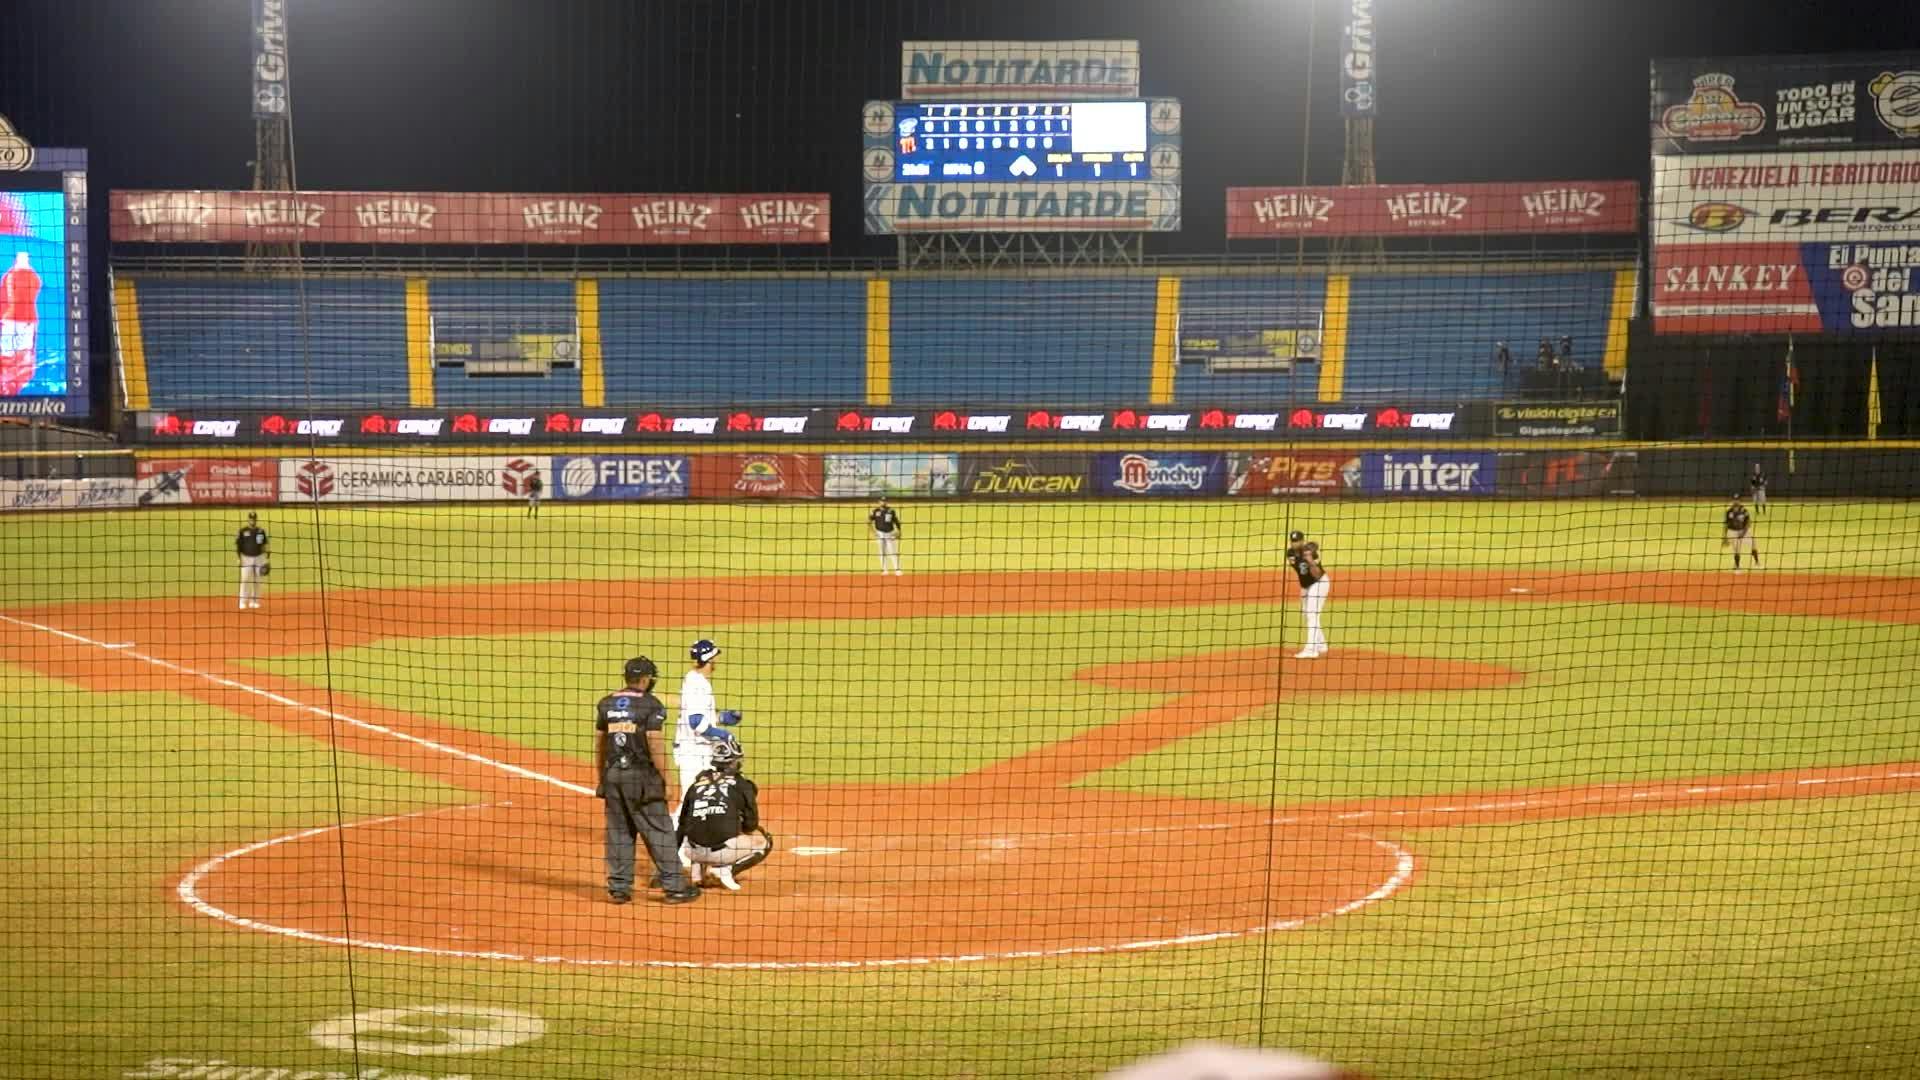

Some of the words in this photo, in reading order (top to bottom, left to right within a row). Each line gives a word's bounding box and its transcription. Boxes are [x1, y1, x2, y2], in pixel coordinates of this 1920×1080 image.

[908, 50, 1131, 84] NOTITARDE
[1776, 84, 1828, 101] TODO
[1831, 80, 1855, 95] EN
[1776, 101, 1802, 114] UN
[1806, 93, 1856, 111] SOLO
[1776, 107, 1856, 131] LUGAR
[1690, 166, 1799, 190] VENEZUELA
[128, 197, 213, 229] HEINZ
[245, 198, 326, 229] HEINZ
[356, 199, 436, 229] HEINZ
[523, 200, 603, 230] HEINZ
[632, 200, 712, 230] HEINZ
[740, 201, 820, 230] HEINZ
[897, 185, 1151, 219] NOTITARDE
[1254, 192, 1334, 223] HEINZ
[1386, 191, 1468, 220] HEINZ
[1522, 189, 1606, 219] HEINZ
[1663, 264, 1797, 293] SANKEY
[1872, 267, 1911, 292] del
[341, 471, 413, 489] CERAMICA
[417, 470, 496, 487] CARABOBO
[599, 460, 683, 485] FIBEX
[1116, 455, 1203, 493] Munchy
[1383, 454, 1480, 492] inter
